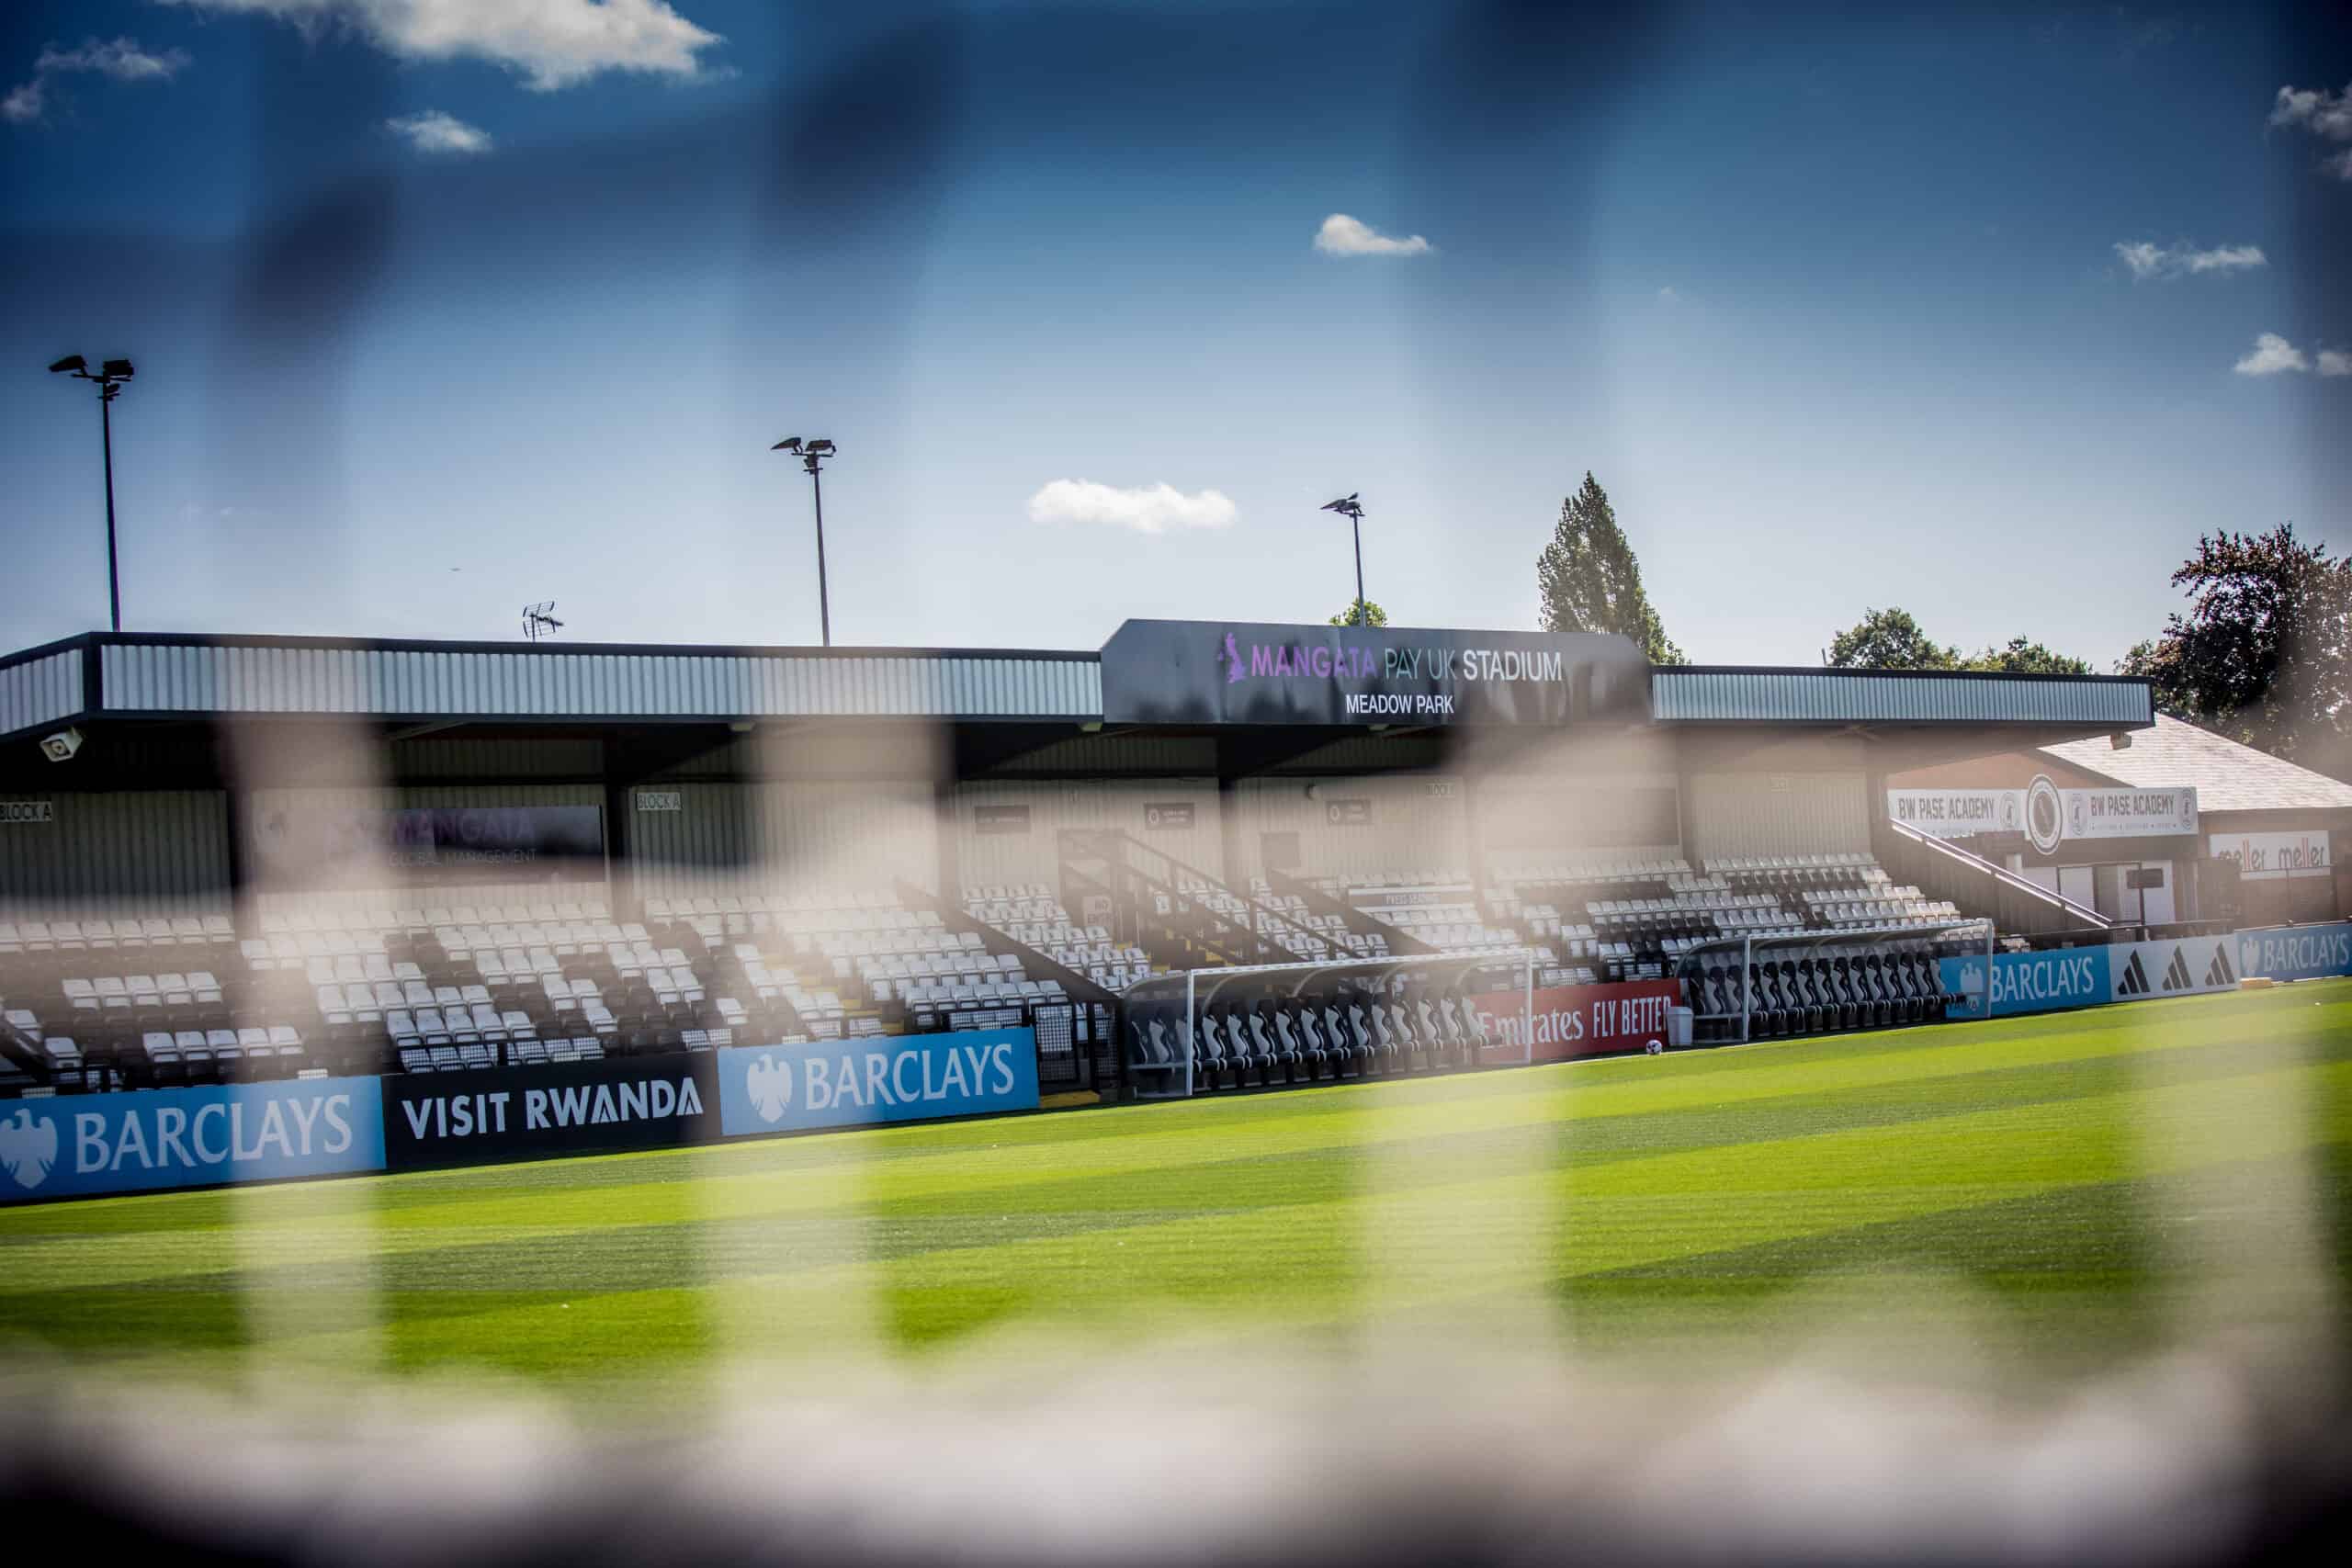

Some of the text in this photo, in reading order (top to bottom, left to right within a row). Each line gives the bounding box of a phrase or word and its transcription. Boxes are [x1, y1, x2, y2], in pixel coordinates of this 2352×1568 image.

[1250, 644, 1563, 682] MANGATA PAY UK STADIUM
[1345, 694, 1454, 715] MEADOW PARK
[43, 804, 52, 820] A
[638, 794, 671, 809] BLOCK
[1898, 796, 1916, 820] BW
[1918, 796, 1945, 820] PASE
[1948, 796, 1996, 820] ACADEMY
[2090, 796, 2106, 817] BW
[2108, 795, 2131, 817] PASE
[2132, 795, 2175, 816] ACADEMY
[2278, 837, 2325, 870] meller
[2266, 931, 2349, 972] BARCLAYS
[1991, 955, 2095, 1003] BARCLAYS
[1592, 999, 1617, 1039] FLY
[805, 1043, 1014, 1111] BARCLAYS
[401, 1077, 705, 1140] VISIT RWANDA
[74, 1094, 353, 1175] BARCLAYS
